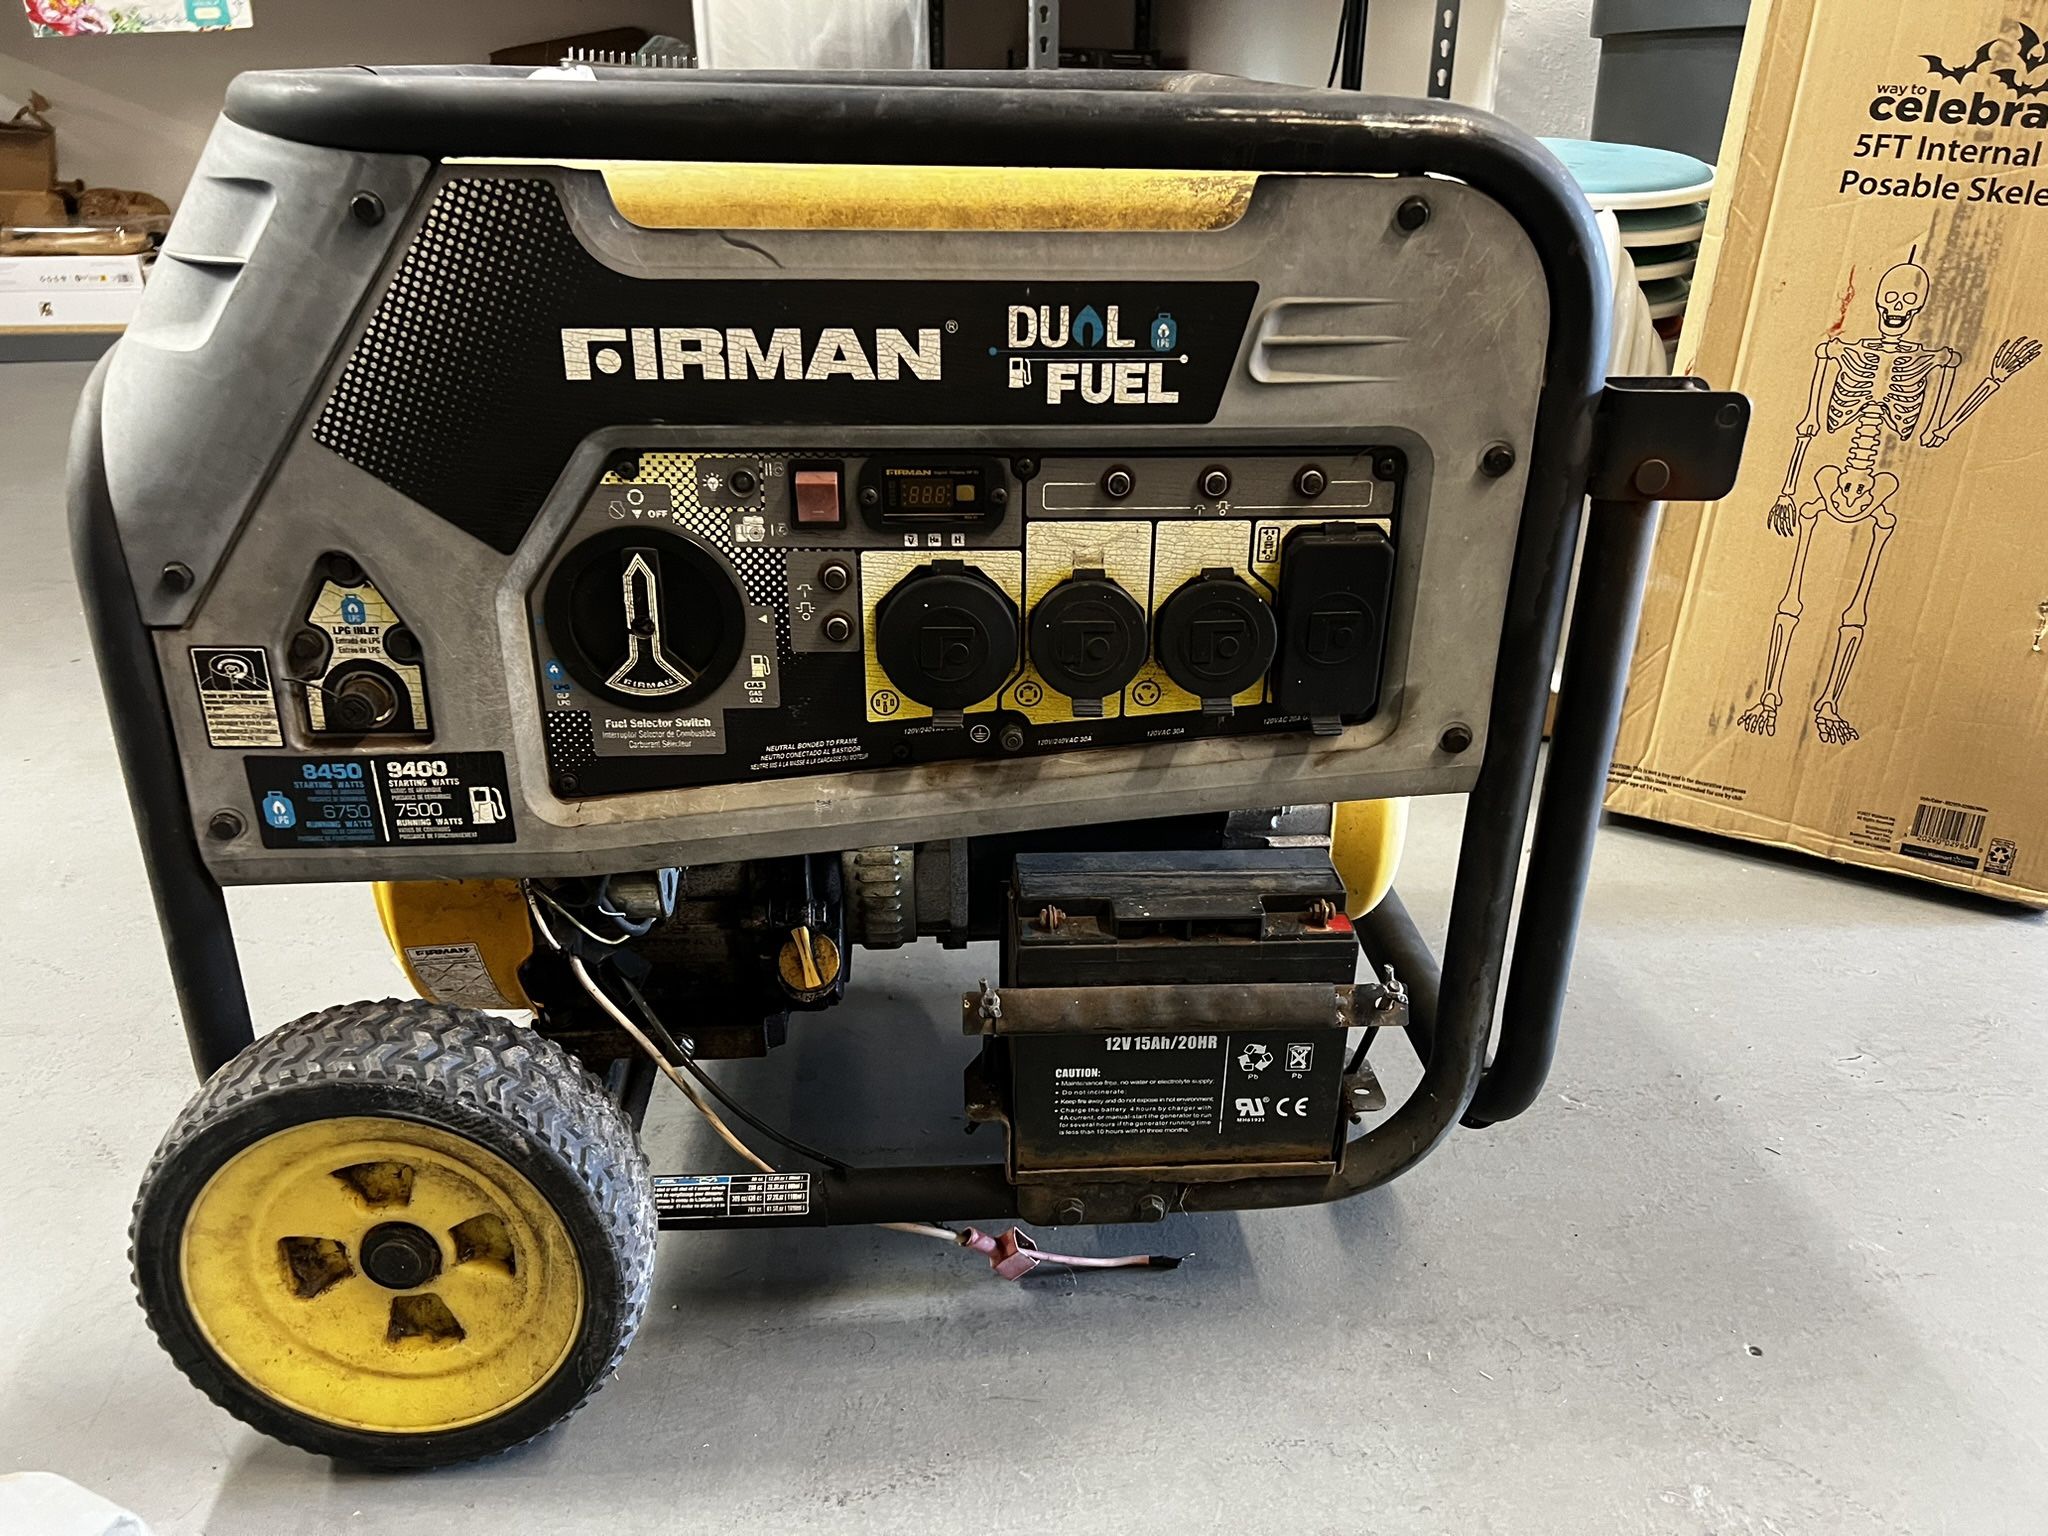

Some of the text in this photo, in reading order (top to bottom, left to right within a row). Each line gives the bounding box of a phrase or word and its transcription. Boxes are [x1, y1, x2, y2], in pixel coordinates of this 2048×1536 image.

[1877, 84, 1927, 96] way to
[1869, 90, 2048, 129] celebra
[1853, 134, 2042, 167] 5FT Internal
[1839, 170, 2048, 206] Posable Skele
[1047, 363, 1179, 404] FUEL
[648, 510, 668, 518] OFF
[332, 626, 379, 635] LPG INLET
[624, 679, 674, 688] FIRMAN
[605, 718, 711, 728] Fuel Selector Switch
[638, 730, 665, 738] Selector
[666, 730, 675, 738] de
[1147, 728, 1185, 737] 120VAC 30A
[766, 744, 796, 752] NEUTRAL
[797, 741, 824, 750] BONDED
[836, 737, 858, 745] FRAME
[760, 753, 784, 761] NEUTRO
[786, 749, 822, 759] CONECTADO
[832, 745, 861, 755] BASTIDOR
[302, 763, 362, 779] 8450
[386, 760, 448, 778] 9400
[388, 778, 460, 787] STARTING WATTS
[1661, 771, 1670, 779] toy
[1695, 778, 1722, 789] decorative
[1722, 785, 1746, 794] purposes
[1682, 783, 1706, 794] intended
[323, 804, 371, 819] 6750
[394, 802, 442, 817] 7500
[275, 816, 289, 825] LPG
[396, 818, 463, 827] RUNNING WATTS
[416, 947, 469, 956] FIRMAN
[1105, 1036, 1218, 1051] 12V 15Ah/20HR
[1055, 1068, 1101, 1078] CAUTION:
[1276, 1097, 1309, 1117] CE
